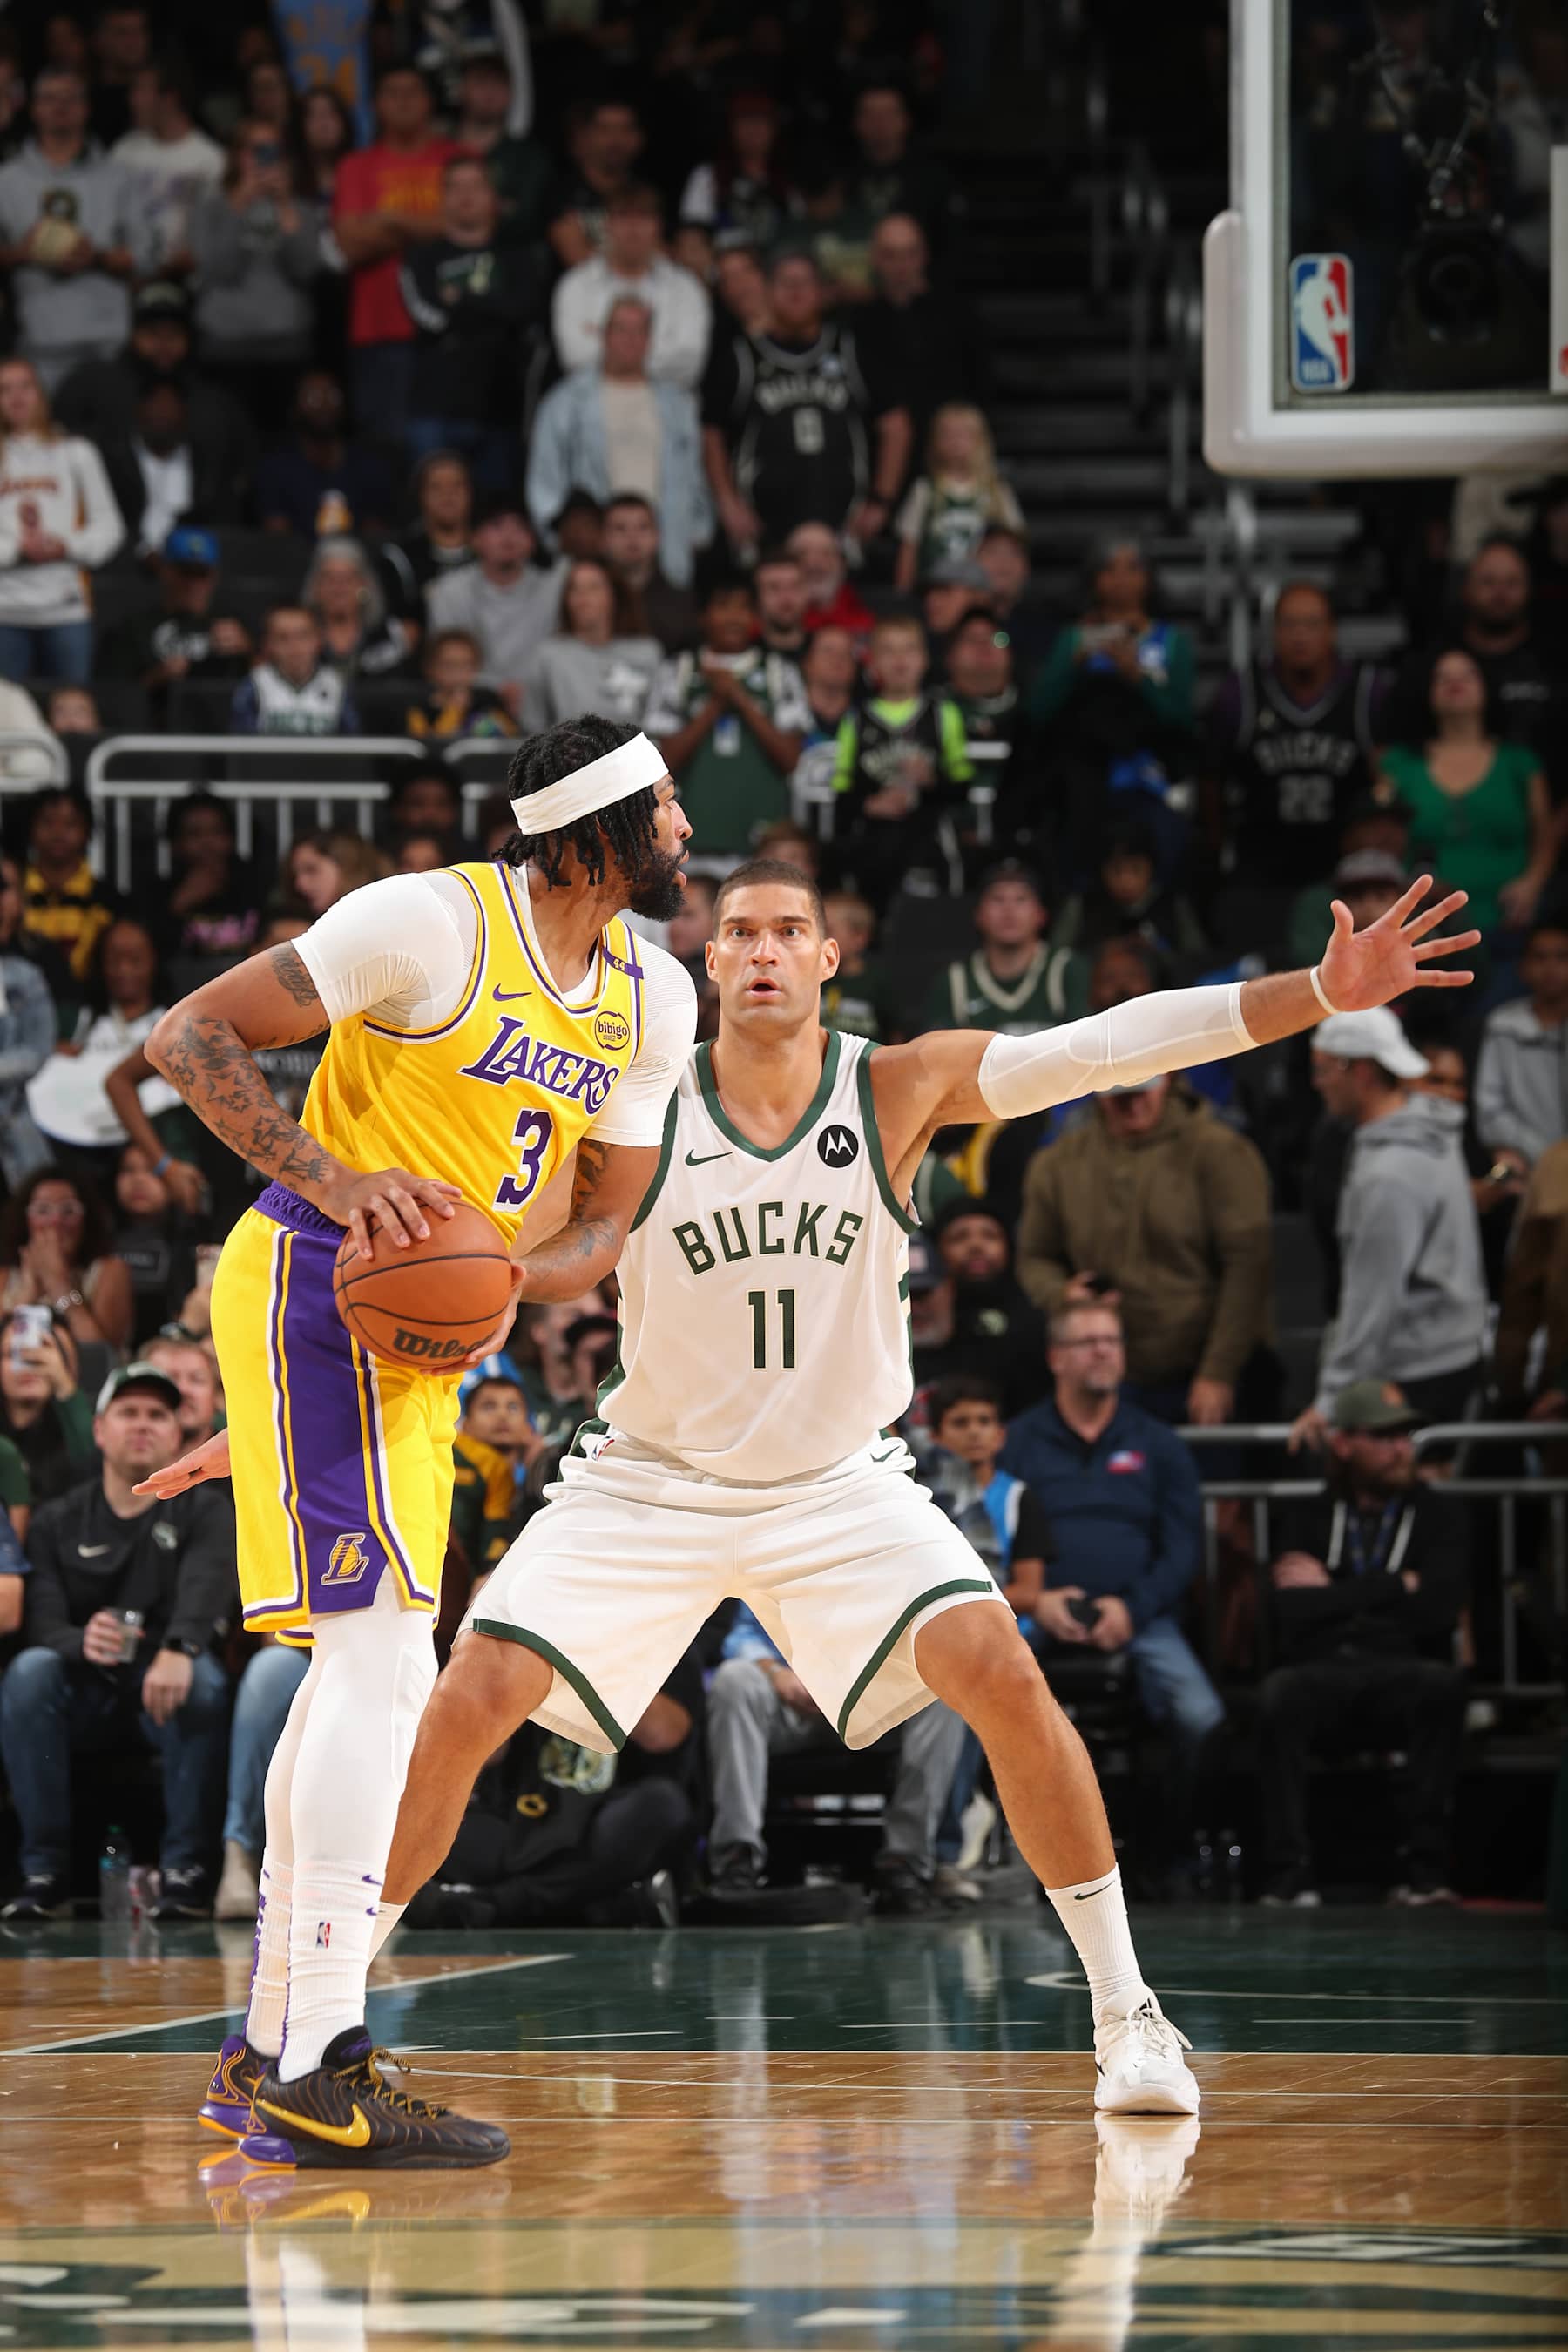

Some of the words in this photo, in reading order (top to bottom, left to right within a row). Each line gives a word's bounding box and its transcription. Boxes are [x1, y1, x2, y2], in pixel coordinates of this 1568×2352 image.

[612, 957, 626, 971] 44
[459, 1015, 620, 1115] LAKERS
[598, 1020, 628, 1040] bibigo
[493, 1109, 553, 1213] 3
[671, 1200, 865, 1277] BUCKS
[747, 1288, 797, 1372] 11
